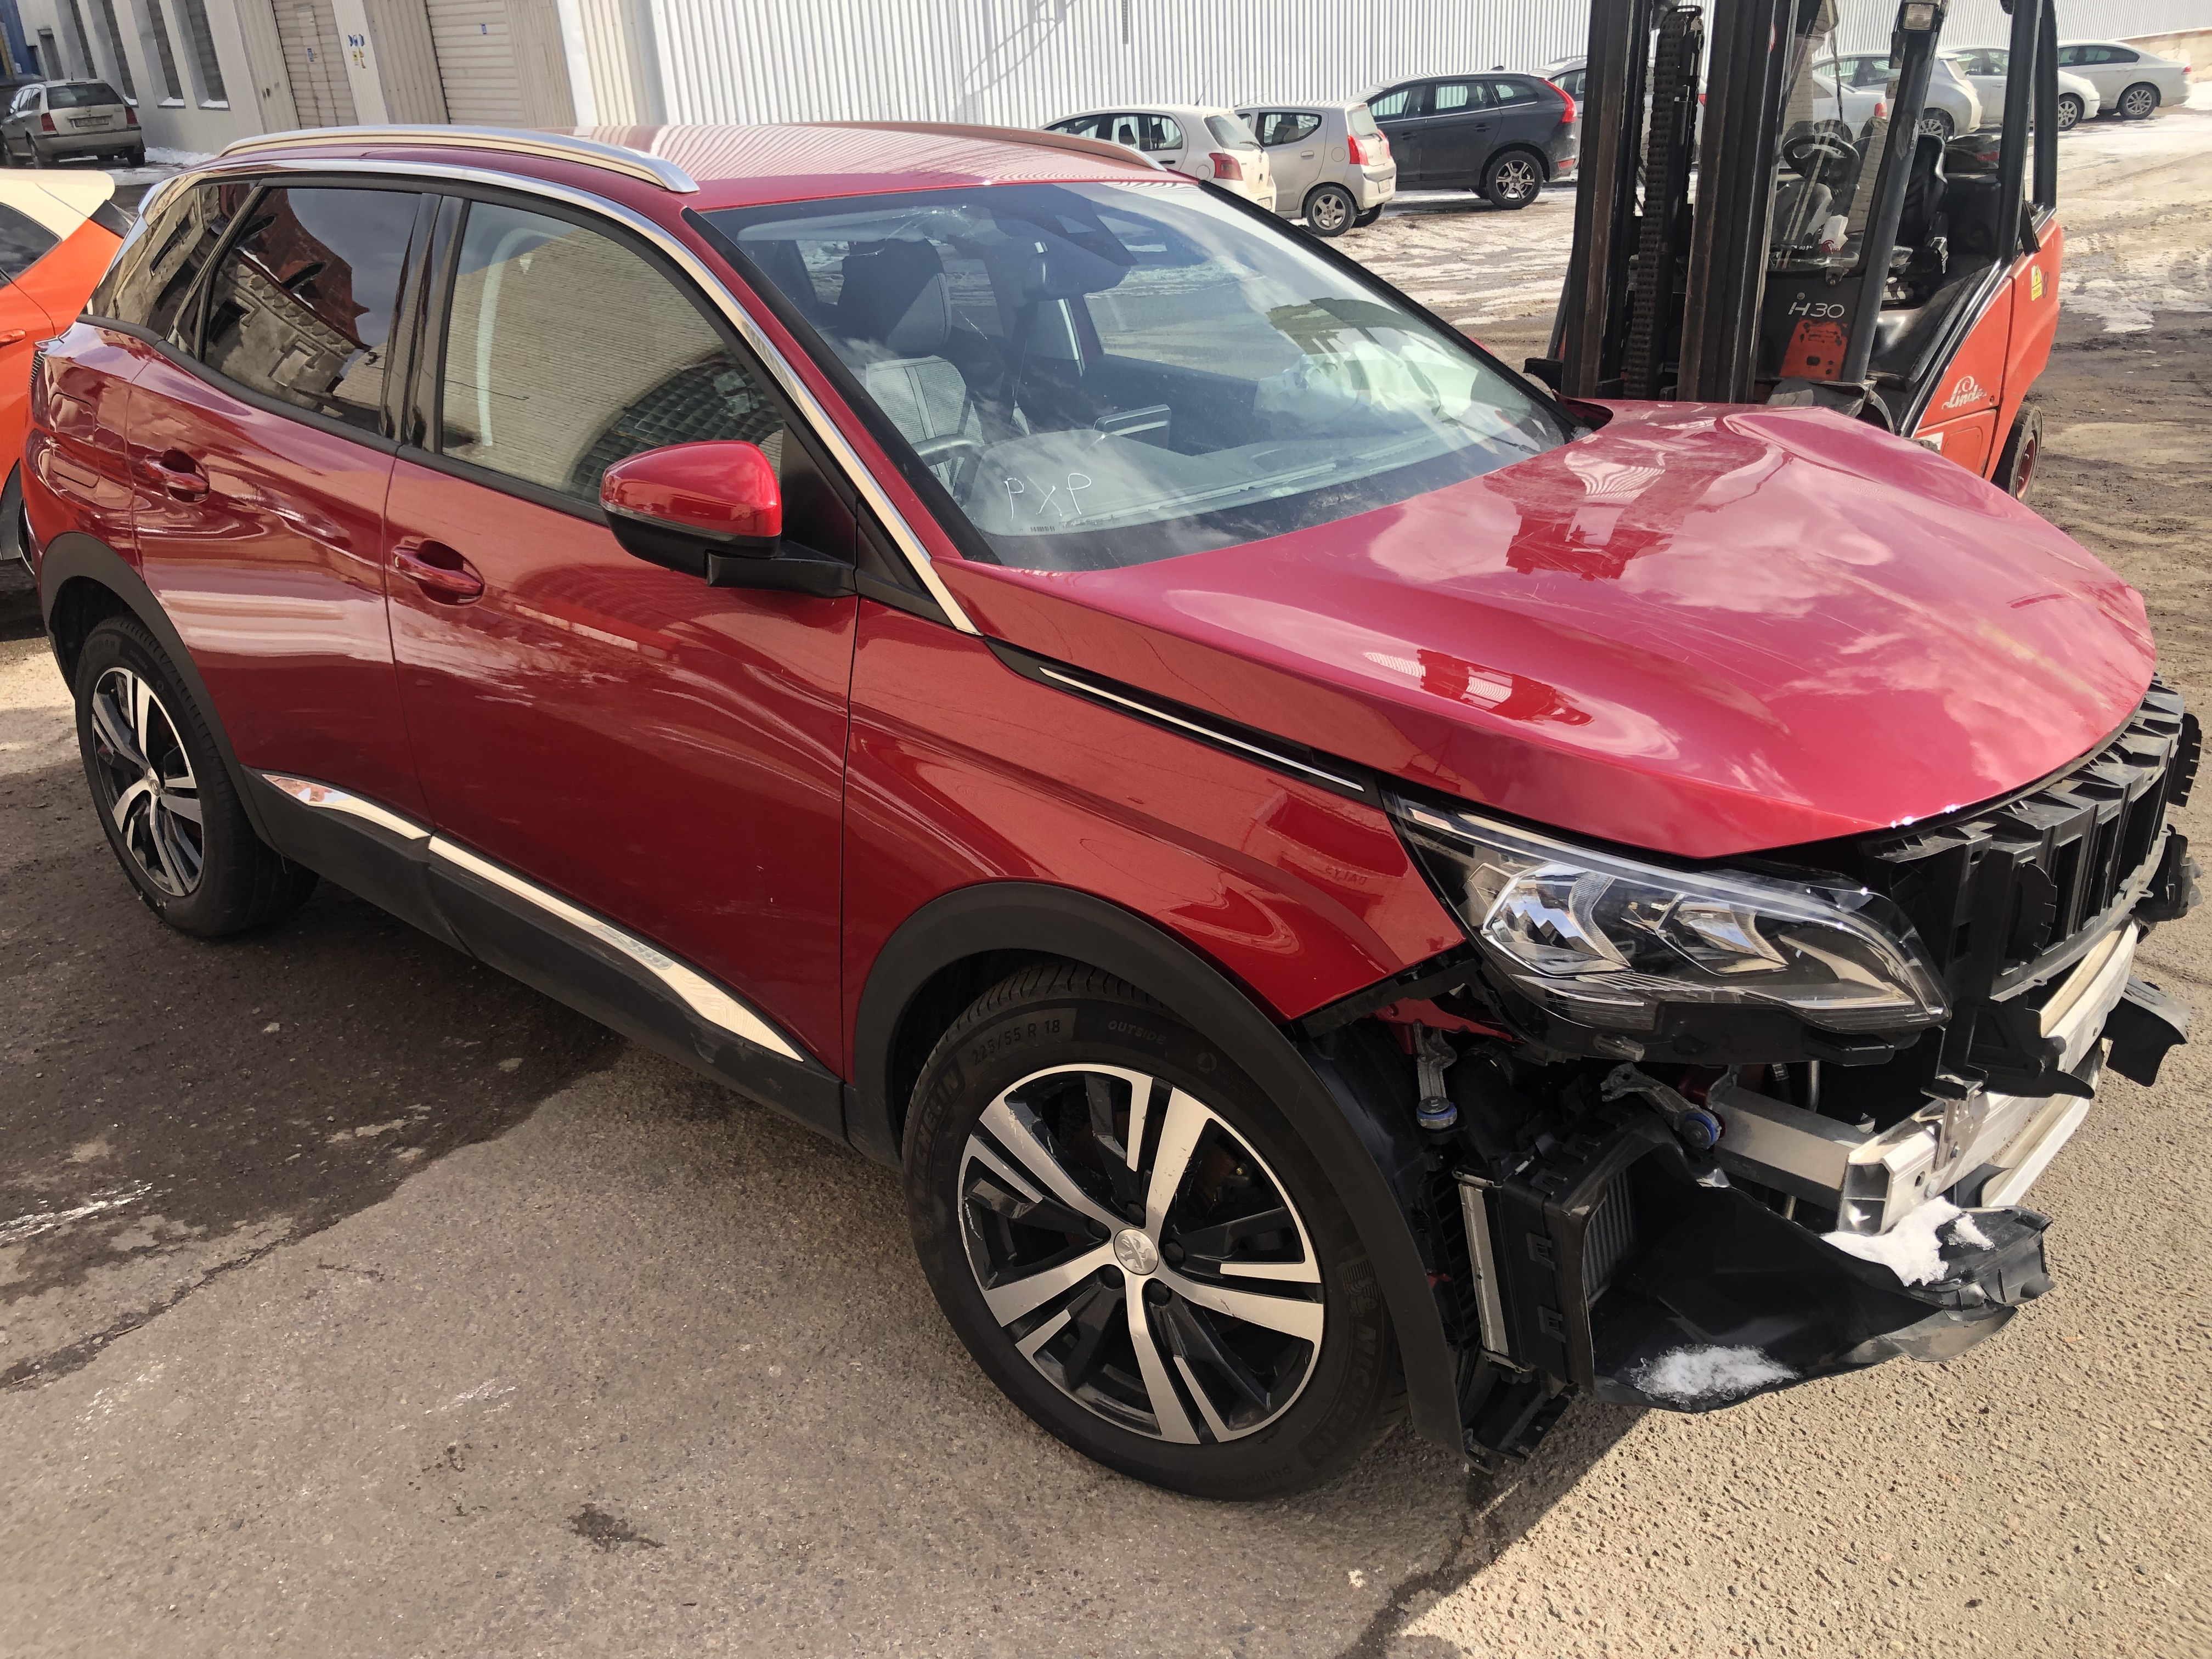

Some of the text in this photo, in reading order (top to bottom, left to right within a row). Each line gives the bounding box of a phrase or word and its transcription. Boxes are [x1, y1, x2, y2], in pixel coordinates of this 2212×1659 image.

[1003, 472, 1092, 521] PXP
[972, 1019, 1060, 1066] 225/55 R 18
[1108, 1019, 1167, 1045] OUTSIDE
